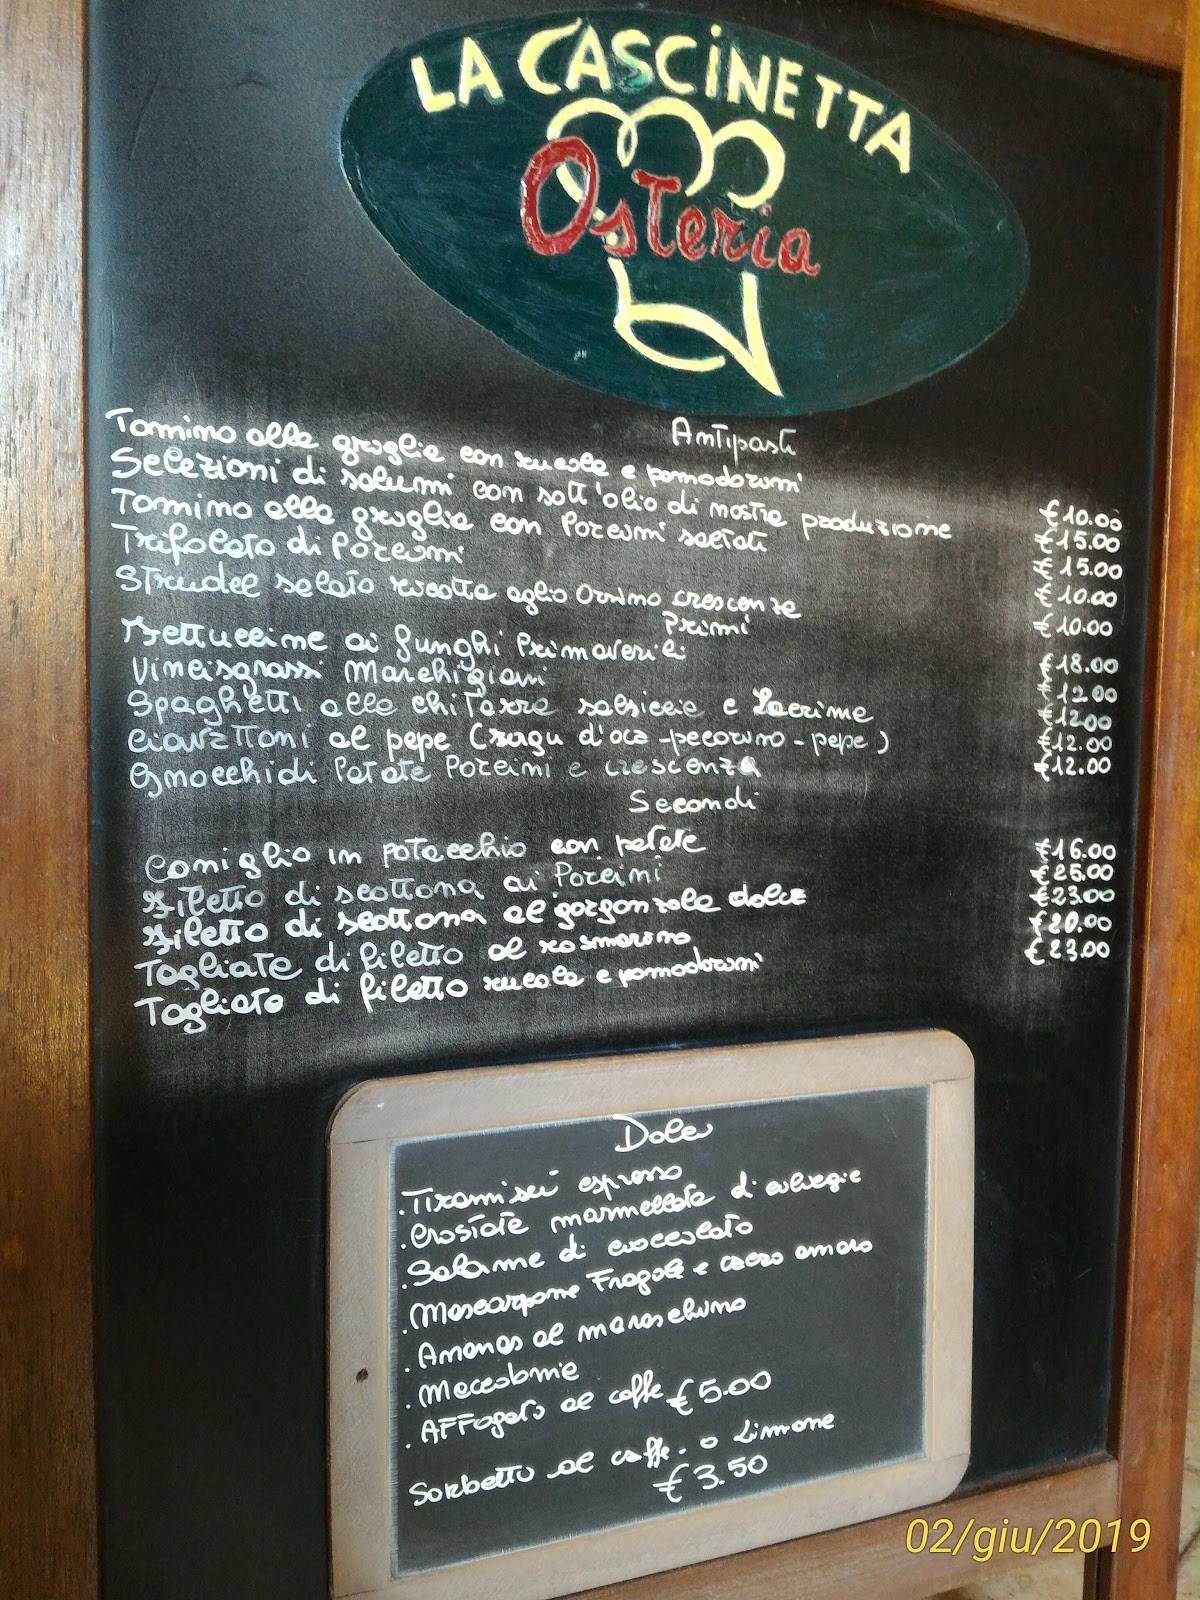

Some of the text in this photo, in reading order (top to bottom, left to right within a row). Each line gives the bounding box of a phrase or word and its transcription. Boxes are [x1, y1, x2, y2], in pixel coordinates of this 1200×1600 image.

[411, 37, 503, 113] LA
[520, 136, 821, 277] Osteria
[672, 416, 797, 466] Antipasti
[460, 445, 503, 468] con
[621, 464, 636, 480] e
[110, 447, 281, 484] Selezioni
[292, 455, 326, 486] di
[341, 465, 455, 496] salumi
[473, 480, 523, 503] con
[667, 489, 699, 515] di
[801, 510, 952, 541] produzione
[287, 525, 322, 557] di
[490, 512, 542, 536] con
[661, 610, 751, 637] Primi
[344, 632, 380, 653] ai
[127, 685, 302, 726] Spaghetti
[722, 697, 738, 716] e
[328, 725, 370, 750] al
[386, 728, 450, 762] pepe
[446, 754, 553, 779] Porcini
[567, 761, 588, 778] e
[628, 786, 760, 814] Secondi
[144, 841, 311, 884] Coniglio
[327, 848, 363, 865] in
[550, 836, 600, 856] con
[284, 880, 322, 907] di
[503, 870, 540, 893] ai
[284, 908, 322, 939] di
[503, 900, 546, 925] al
[314, 941, 351, 973] di
[488, 936, 528, 961] al
[304, 977, 340, 1005] di
[596, 968, 613, 983] e
[558, 1234, 587, 1263] di
[692, 1261, 709, 1276] e
[532, 1322, 564, 1348] al
[560, 1390, 595, 1413] al
[546, 1451, 595, 1479] al
